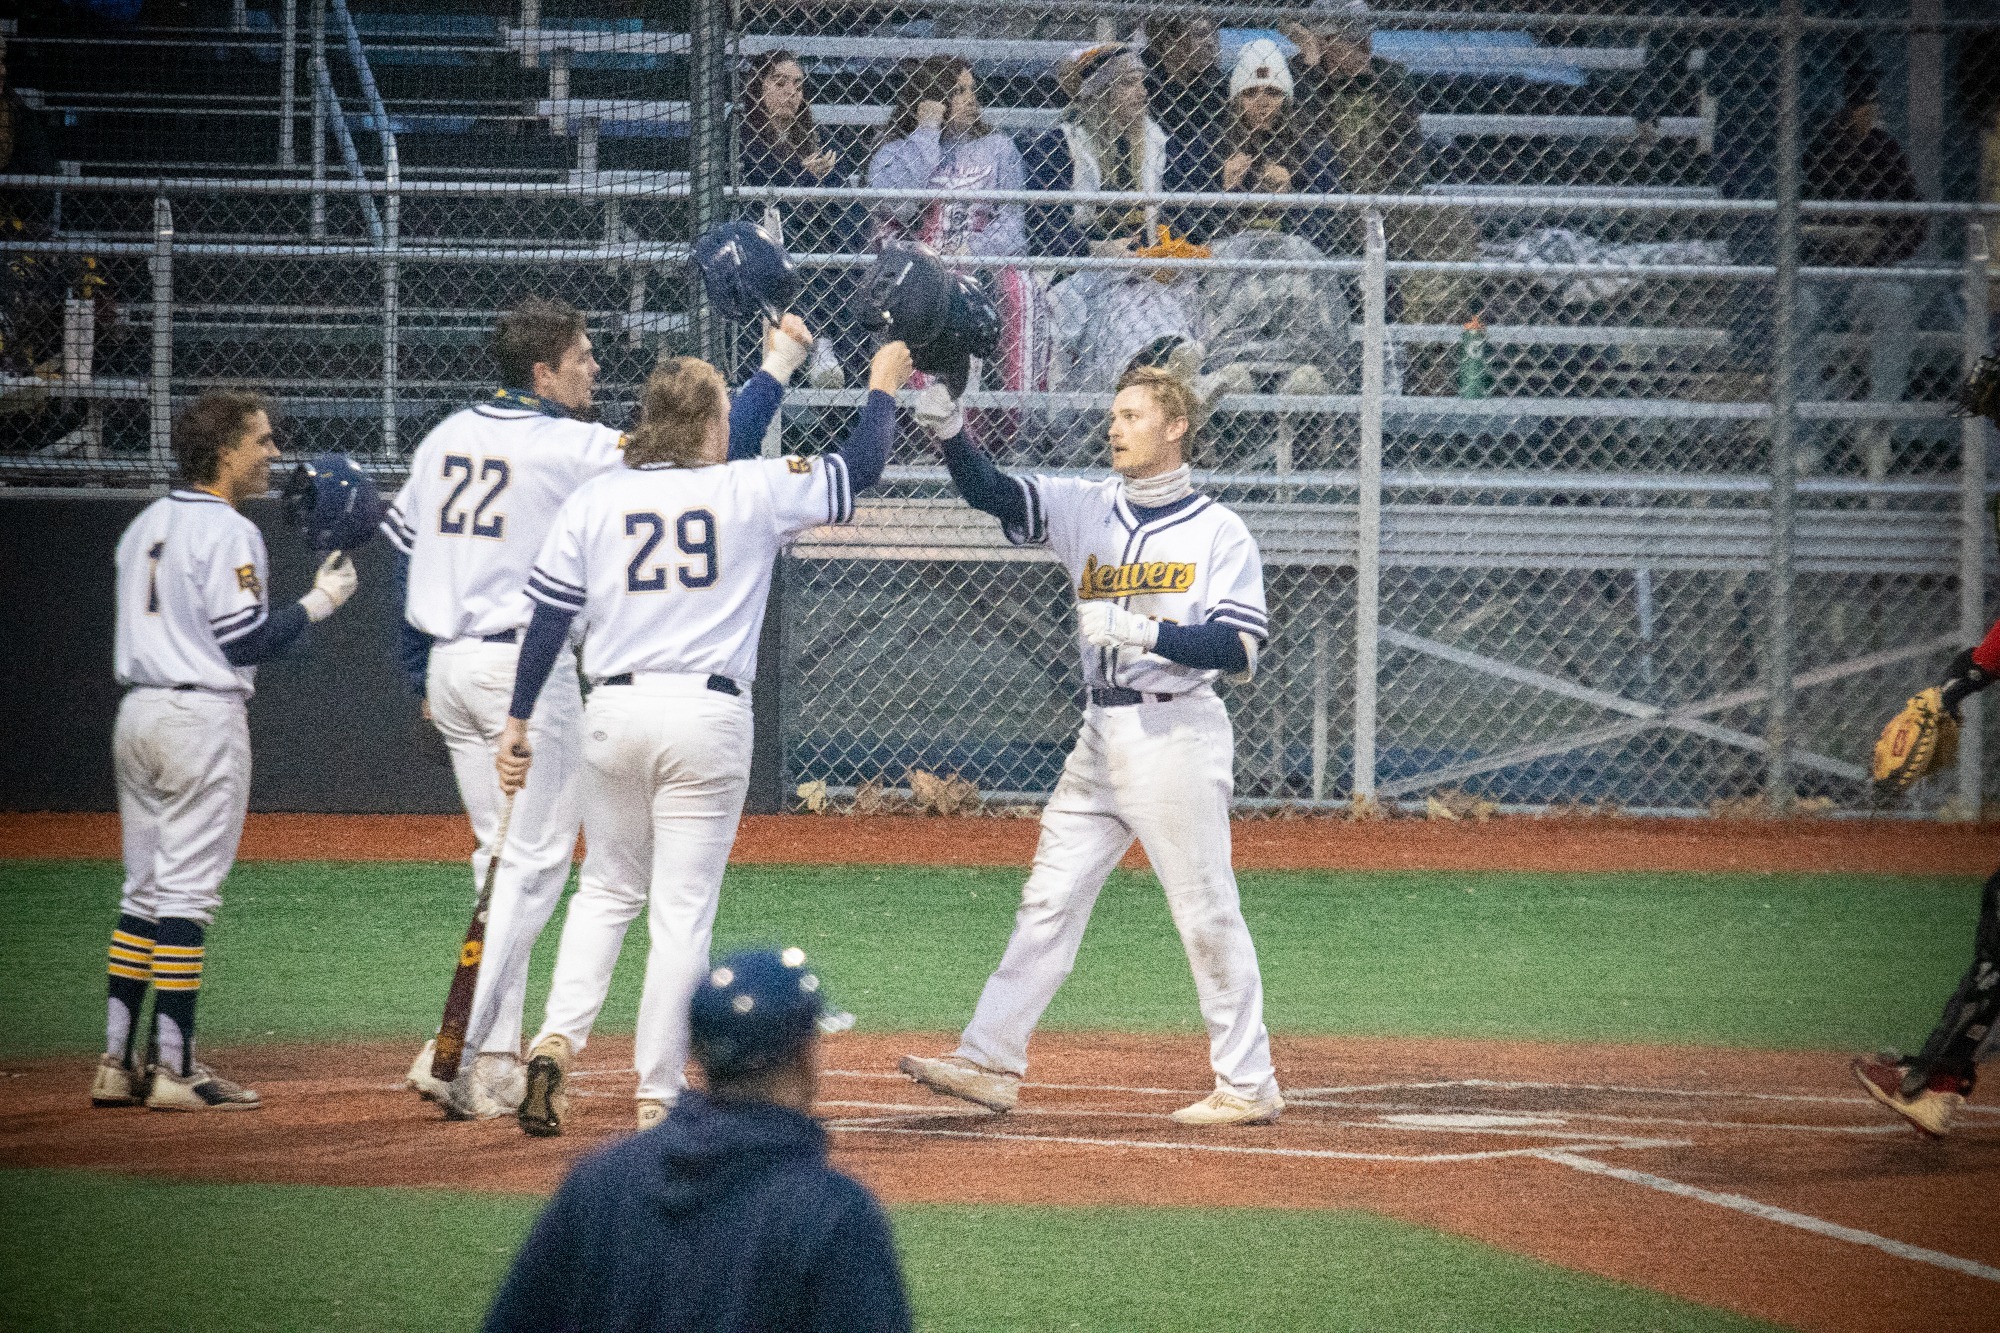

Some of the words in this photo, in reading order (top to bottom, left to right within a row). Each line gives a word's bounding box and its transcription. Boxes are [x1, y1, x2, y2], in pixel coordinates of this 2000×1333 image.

[439, 454, 509, 538] 22
[146, 540, 164, 614] 1
[624, 507, 720, 592] 29
